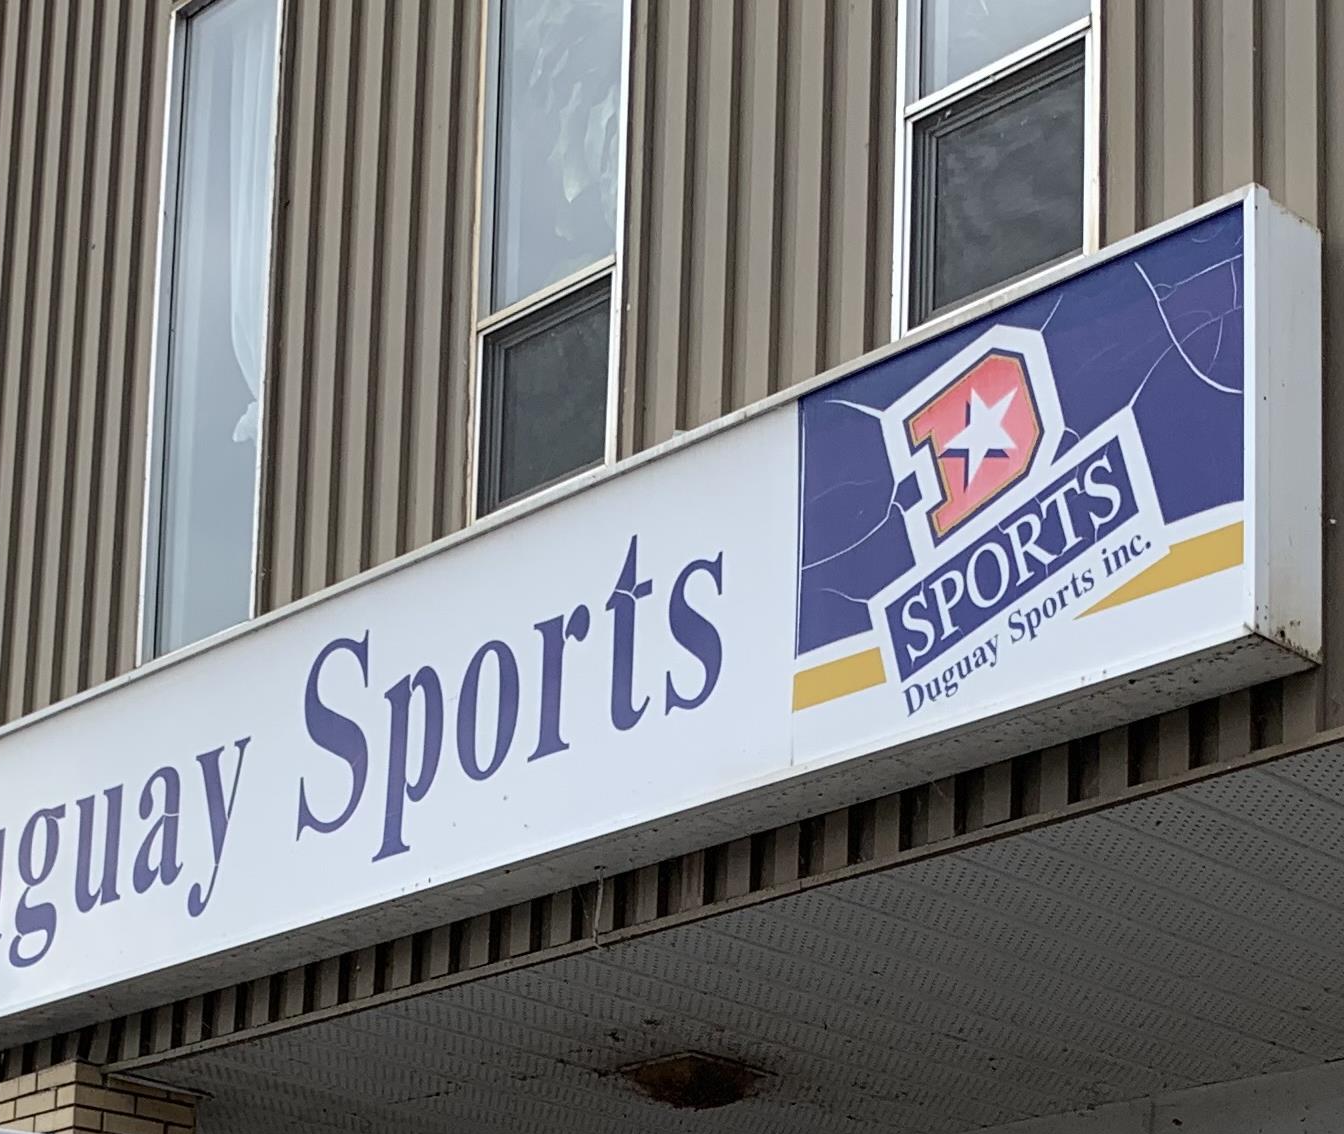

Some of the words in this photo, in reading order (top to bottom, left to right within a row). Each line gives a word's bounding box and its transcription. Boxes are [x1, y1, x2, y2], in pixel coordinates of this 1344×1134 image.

[901, 453, 1123, 662] SPORTS
[902, 634, 1001, 717] Duguay
[1007, 569, 1095, 645] Sports
[1102, 534, 1153, 578] inc.
[296, 533, 724, 863] Sports
